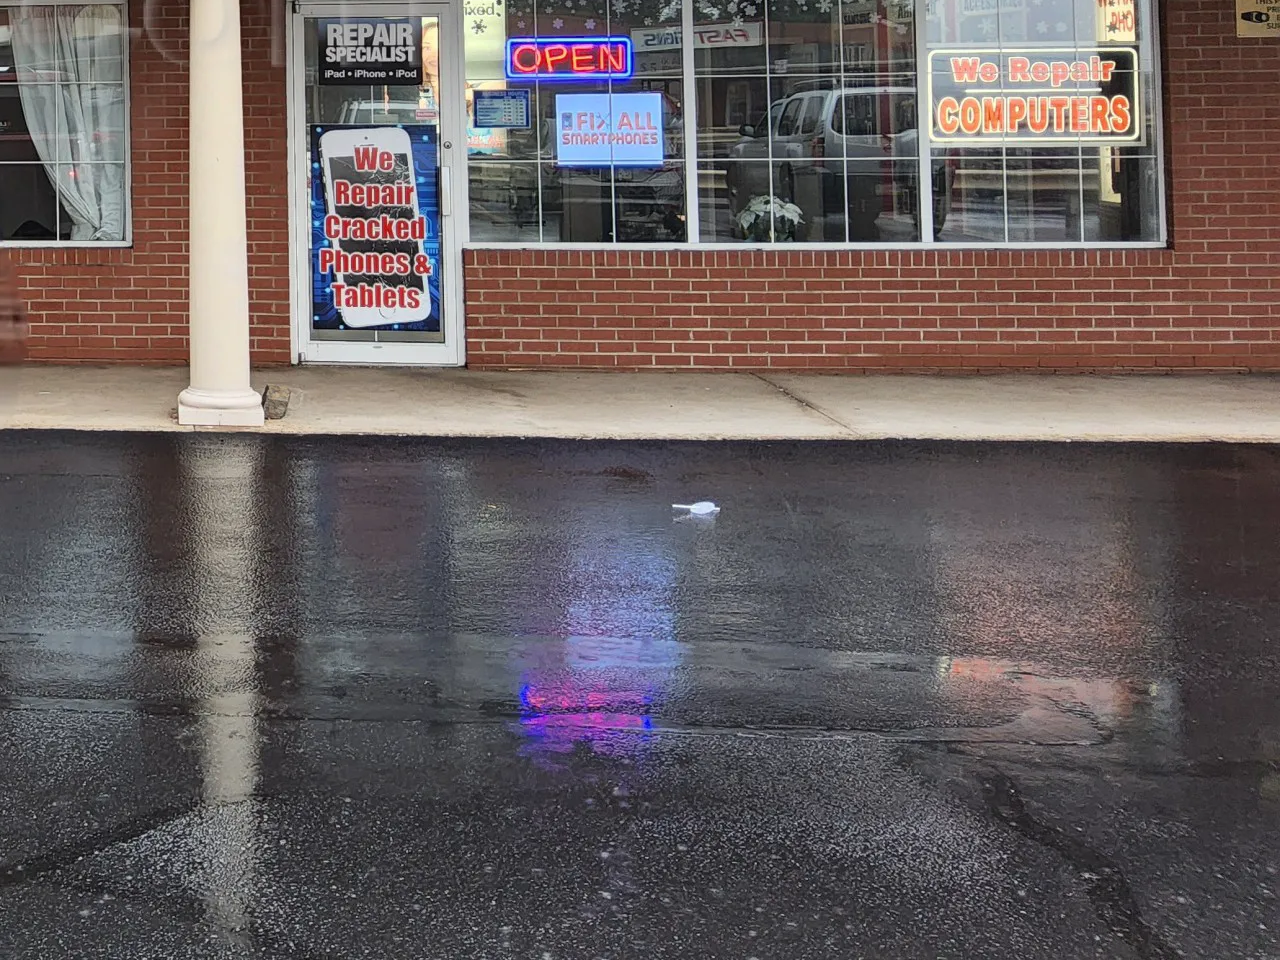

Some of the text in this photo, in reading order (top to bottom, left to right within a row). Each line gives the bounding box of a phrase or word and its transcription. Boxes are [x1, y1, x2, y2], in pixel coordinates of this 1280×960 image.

[463, 2, 495, 16] ixed
[326, 23, 414, 46] REPAIR
[325, 46, 416, 63] SPECIALIST
[511, 42, 626, 73] OPEN
[324, 69, 417, 79] iPad iPhone iPod
[949, 55, 1116, 87] We Repair
[616, 110, 658, 131] ALL
[936, 94, 1131, 134] COMPUTERS
[561, 132, 659, 146] SMARTPHONES
[353, 146, 394, 172] We
[334, 180, 415, 207] Repair
[324, 214, 426, 240] Cracked
[319, 248, 433, 275] Phones &
[330, 283, 421, 309] Tablets
